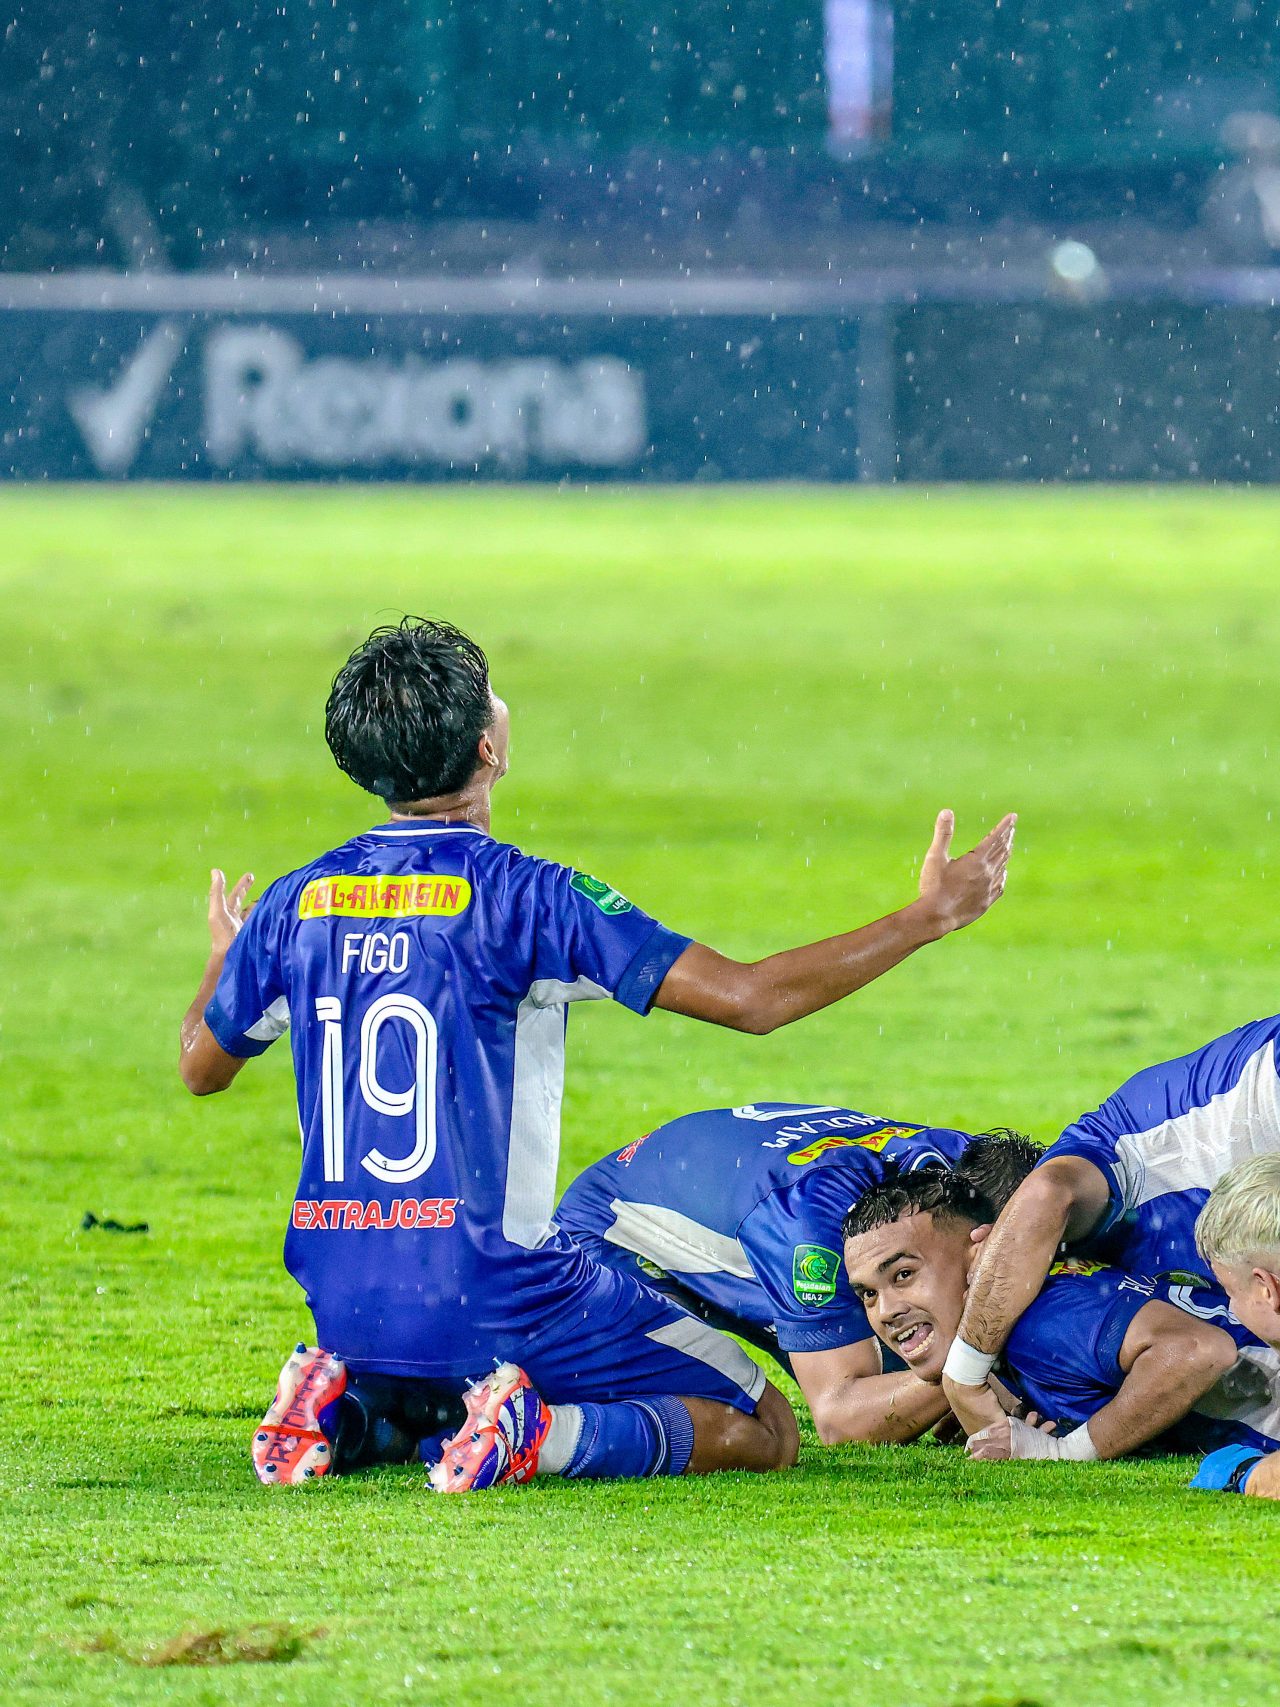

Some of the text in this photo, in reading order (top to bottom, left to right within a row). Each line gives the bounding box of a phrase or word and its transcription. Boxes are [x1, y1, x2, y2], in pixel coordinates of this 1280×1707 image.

[203, 325, 645, 468] Rexona
[341, 931, 410, 974] FIGO
[314, 992, 438, 1184] 19
[292, 1198, 460, 1230] EXTRAJOSS
